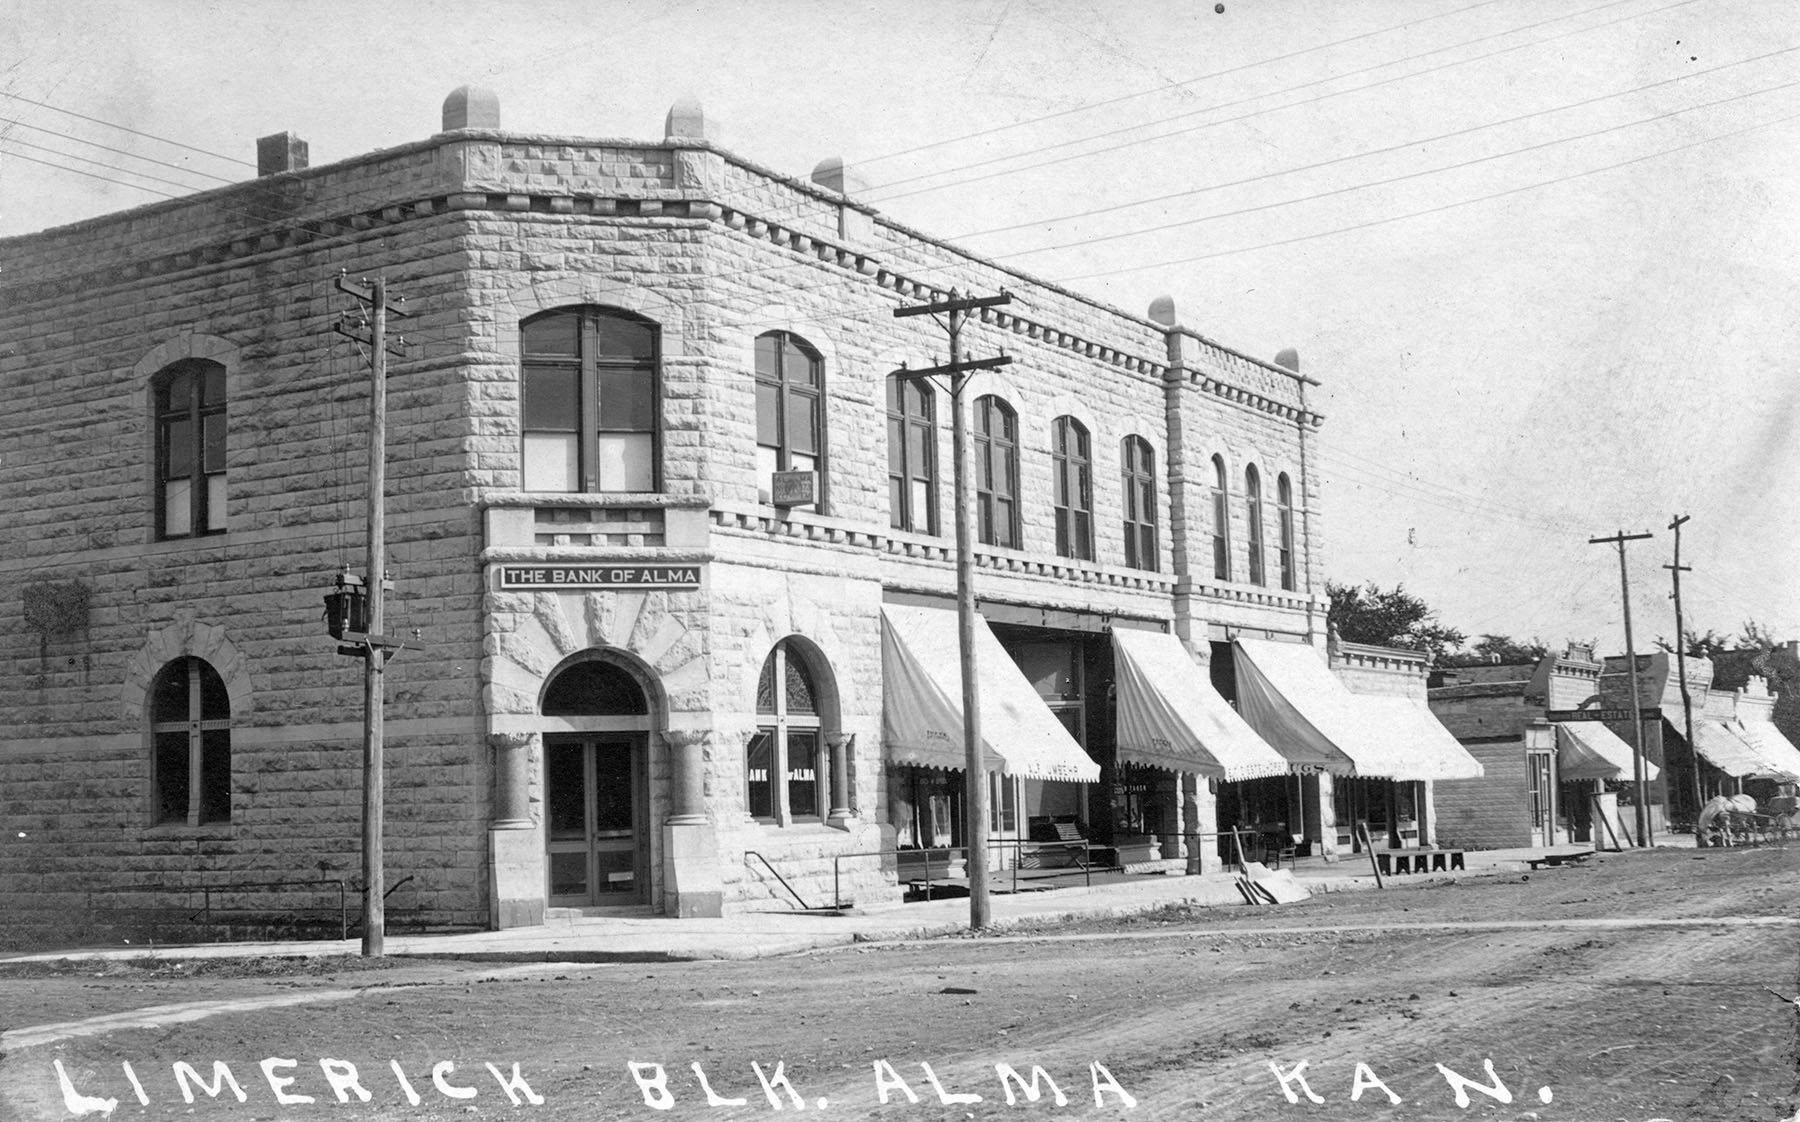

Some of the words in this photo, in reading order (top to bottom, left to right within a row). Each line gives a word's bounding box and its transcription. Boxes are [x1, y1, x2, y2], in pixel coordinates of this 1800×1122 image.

[507, 569, 546, 583] THE
[552, 569, 603, 583] BANK
[611, 569, 636, 583] OF
[640, 569, 697, 583] ALMA
[749, 769, 768, 782] ANK
[793, 768, 816, 781] ALMA
[1290, 763, 1329, 773] UGS.
